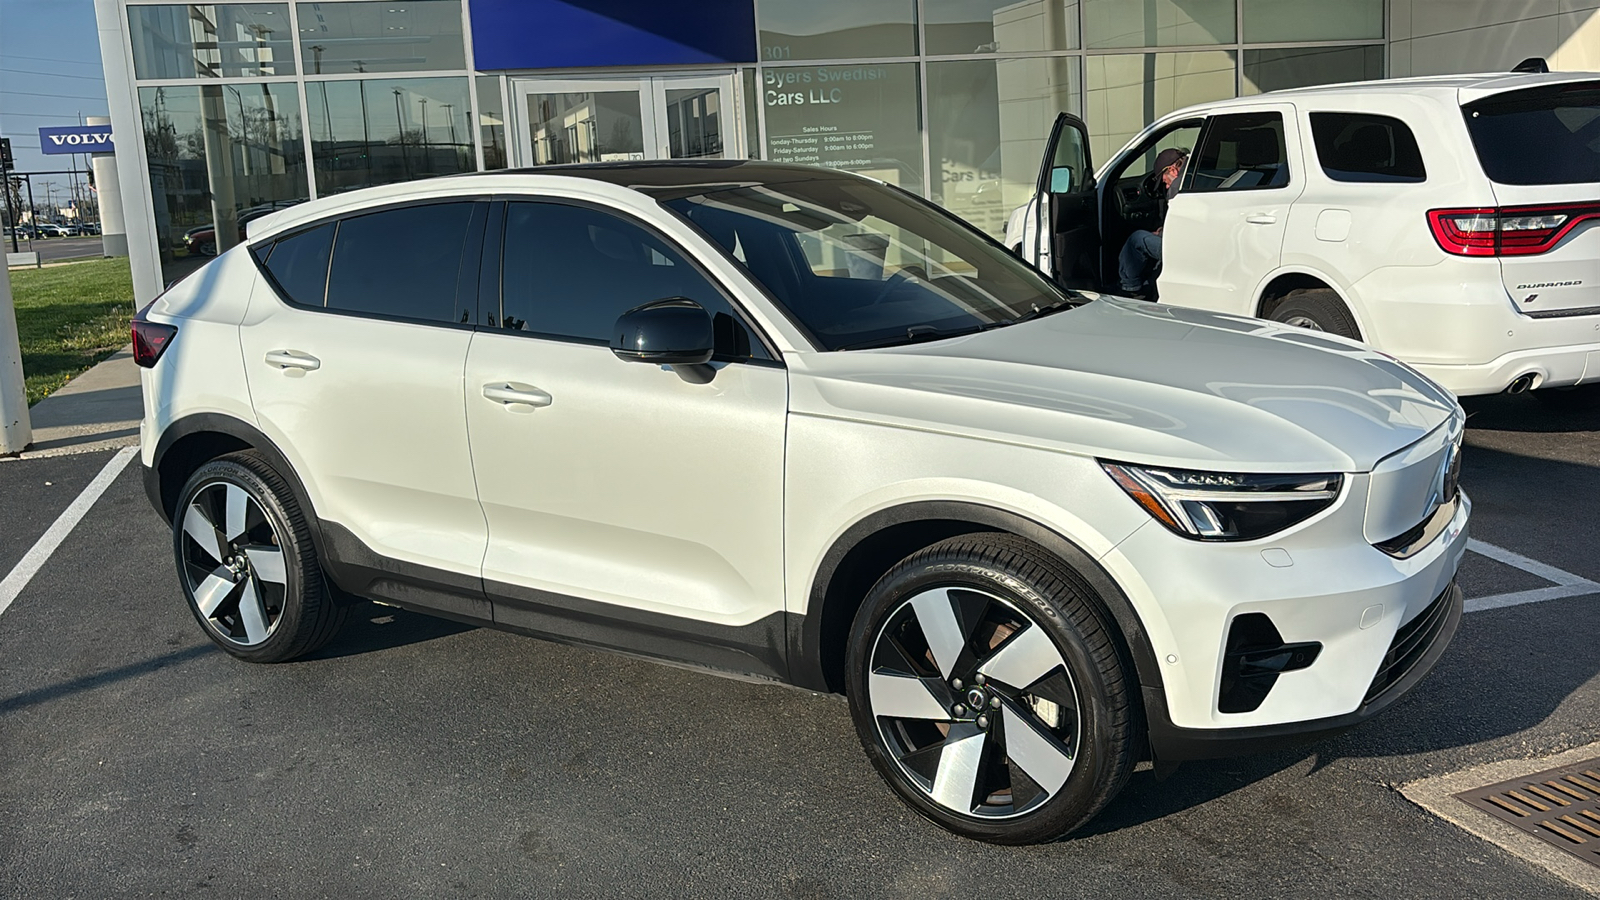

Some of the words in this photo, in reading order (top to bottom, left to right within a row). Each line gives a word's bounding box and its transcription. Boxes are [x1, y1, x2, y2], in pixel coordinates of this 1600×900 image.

[764, 69, 811, 88] Byers
[817, 67, 886, 82] Swedish
[765, 90, 804, 106] Cars
[809, 88, 841, 104] LLC
[794, 155, 820, 163] Sundays
[1516, 280, 1583, 289] DURANGO
[925, 564, 1008, 583] SCORPION
